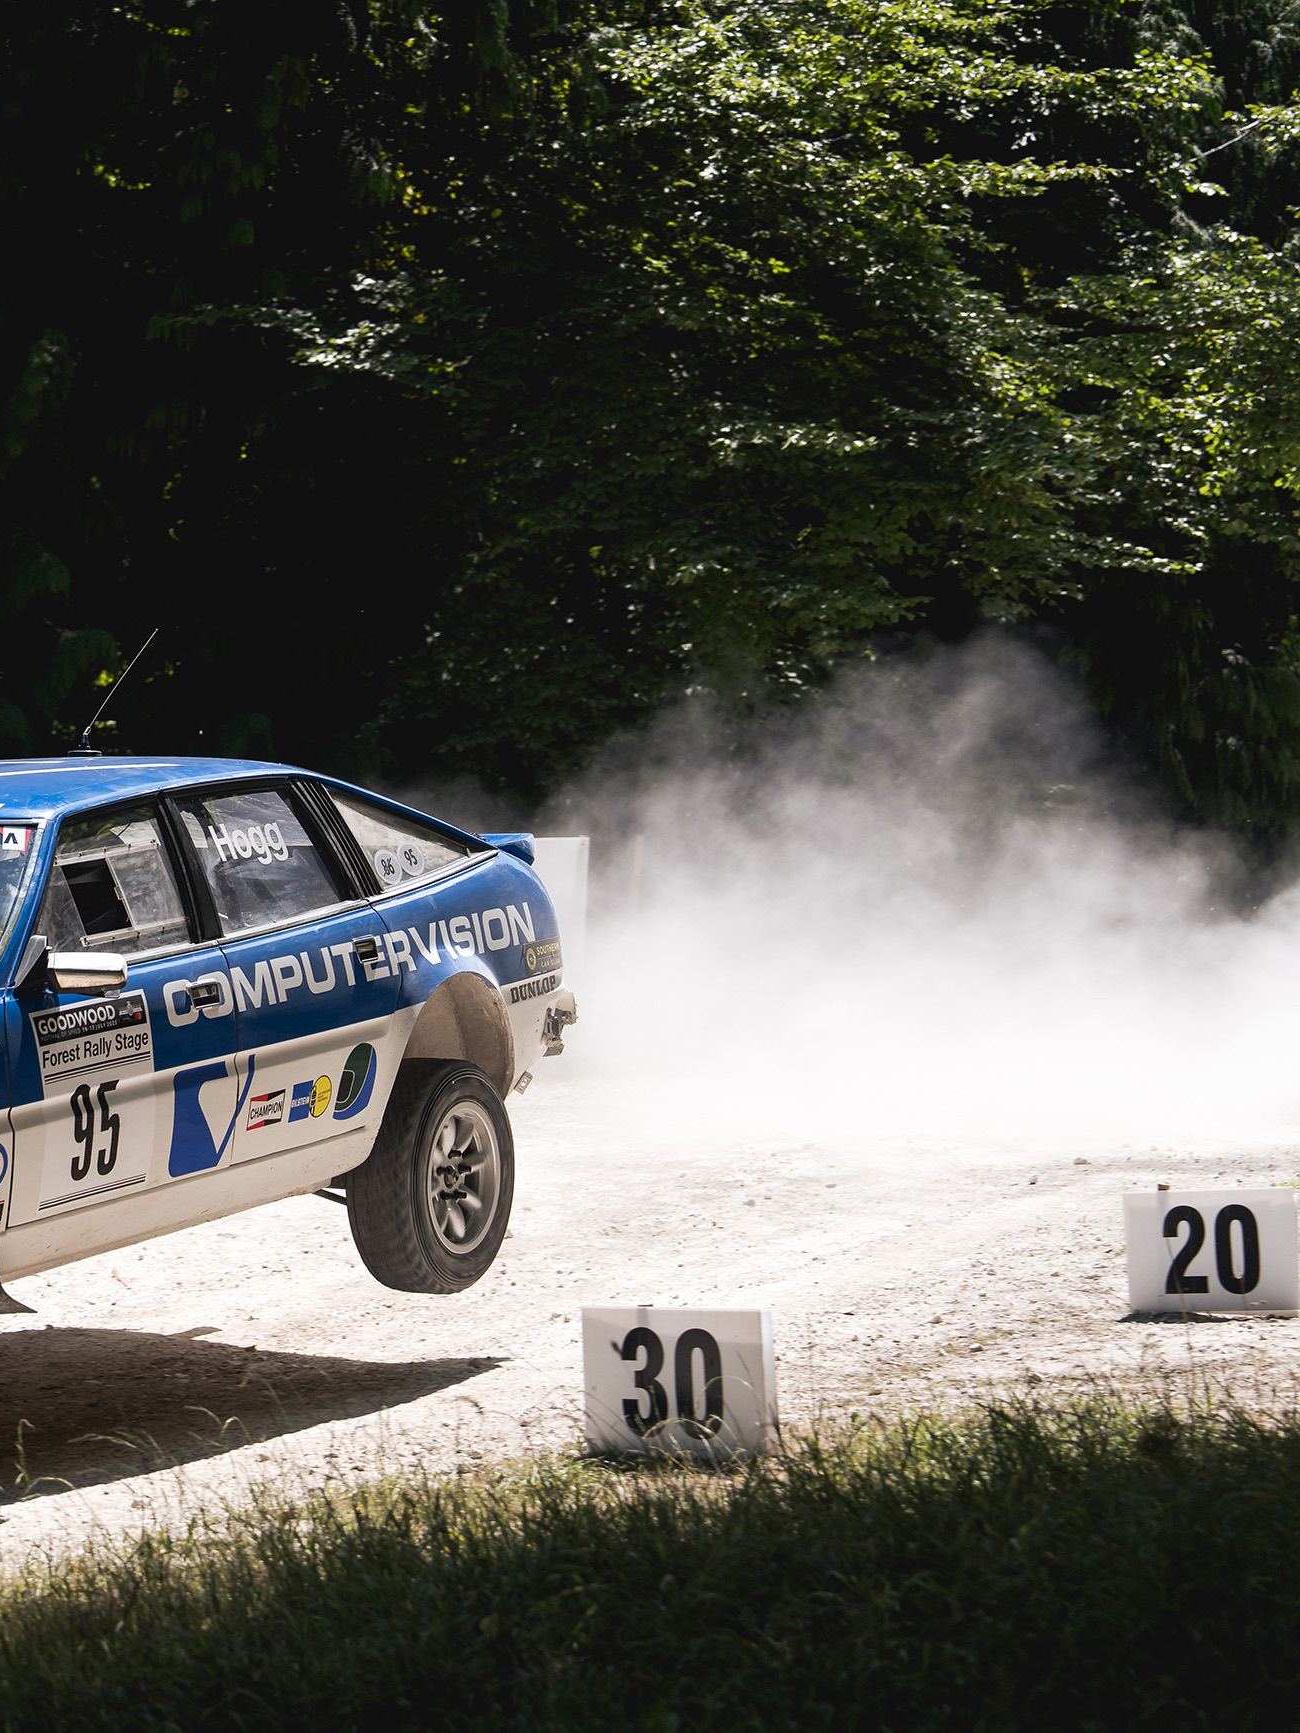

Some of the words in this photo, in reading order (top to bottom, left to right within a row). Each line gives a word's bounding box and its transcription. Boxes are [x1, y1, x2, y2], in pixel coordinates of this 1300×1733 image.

[208, 822, 289, 865] Hogg
[404, 848, 418, 866] 95
[163, 902, 536, 1028] COMPUTERVISION
[536, 942, 560, 956] SOUTHERN
[510, 974, 556, 1004] DUNLOP
[38, 1004, 116, 1035] GOODWOOD
[42, 1044, 81, 1069] Forest
[83, 1037, 112, 1058] Rally
[115, 1031, 149, 1051] Stage
[250, 1100, 284, 1120] CHAMPION
[70, 1079, 119, 1181] 95
[1162, 1203, 1261, 1296] 20
[621, 1326, 725, 1440] 30
